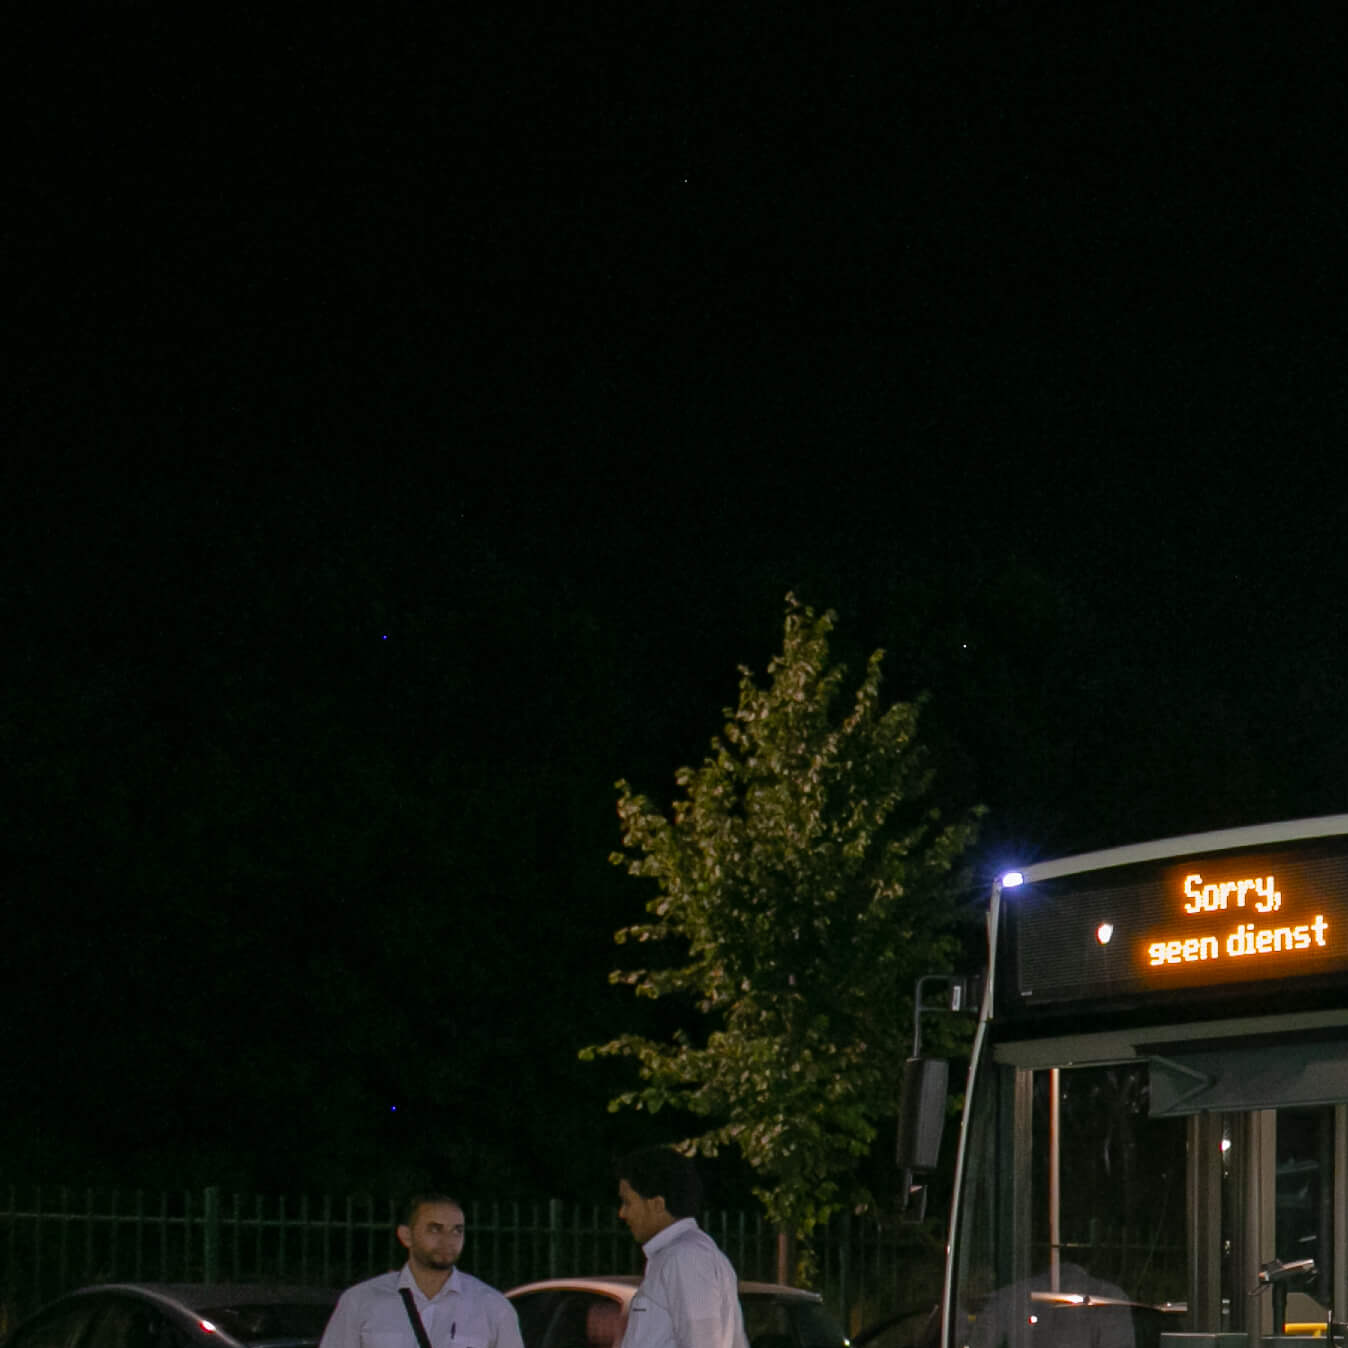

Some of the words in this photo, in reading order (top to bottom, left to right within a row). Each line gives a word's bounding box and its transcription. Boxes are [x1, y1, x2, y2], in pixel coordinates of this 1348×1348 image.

[1183, 873, 1282, 914] Sorry,
[1148, 935, 1219, 966] geen
[1226, 914, 1329, 957] dienst
